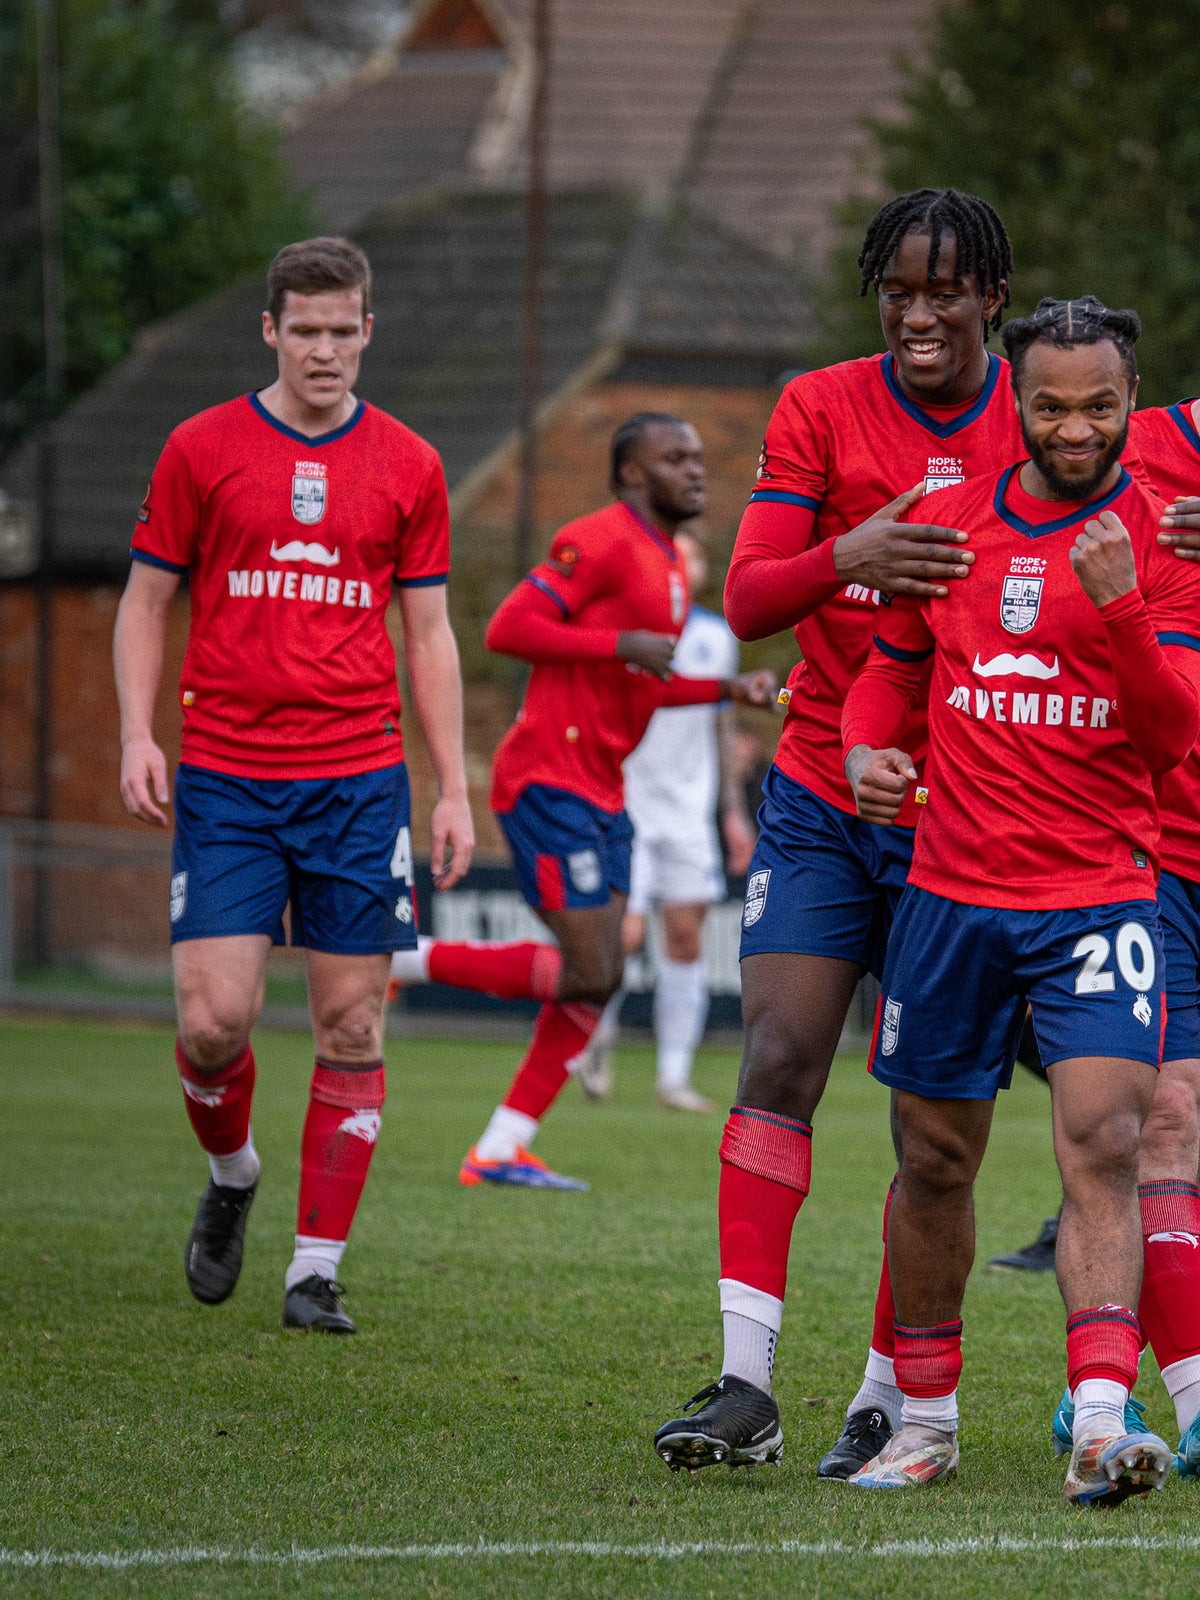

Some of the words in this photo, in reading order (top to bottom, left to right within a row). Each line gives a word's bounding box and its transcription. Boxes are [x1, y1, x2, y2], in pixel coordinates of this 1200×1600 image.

[928, 457, 963, 466] HOPE+
[927, 466, 963, 474] GLORY
[1011, 556, 1048, 566] HOPE+
[1009, 565, 1046, 574] GLORY
[228, 569, 372, 609] MOVEMBER
[390, 826, 413, 887] 4
[1071, 922, 1156, 995] 20
